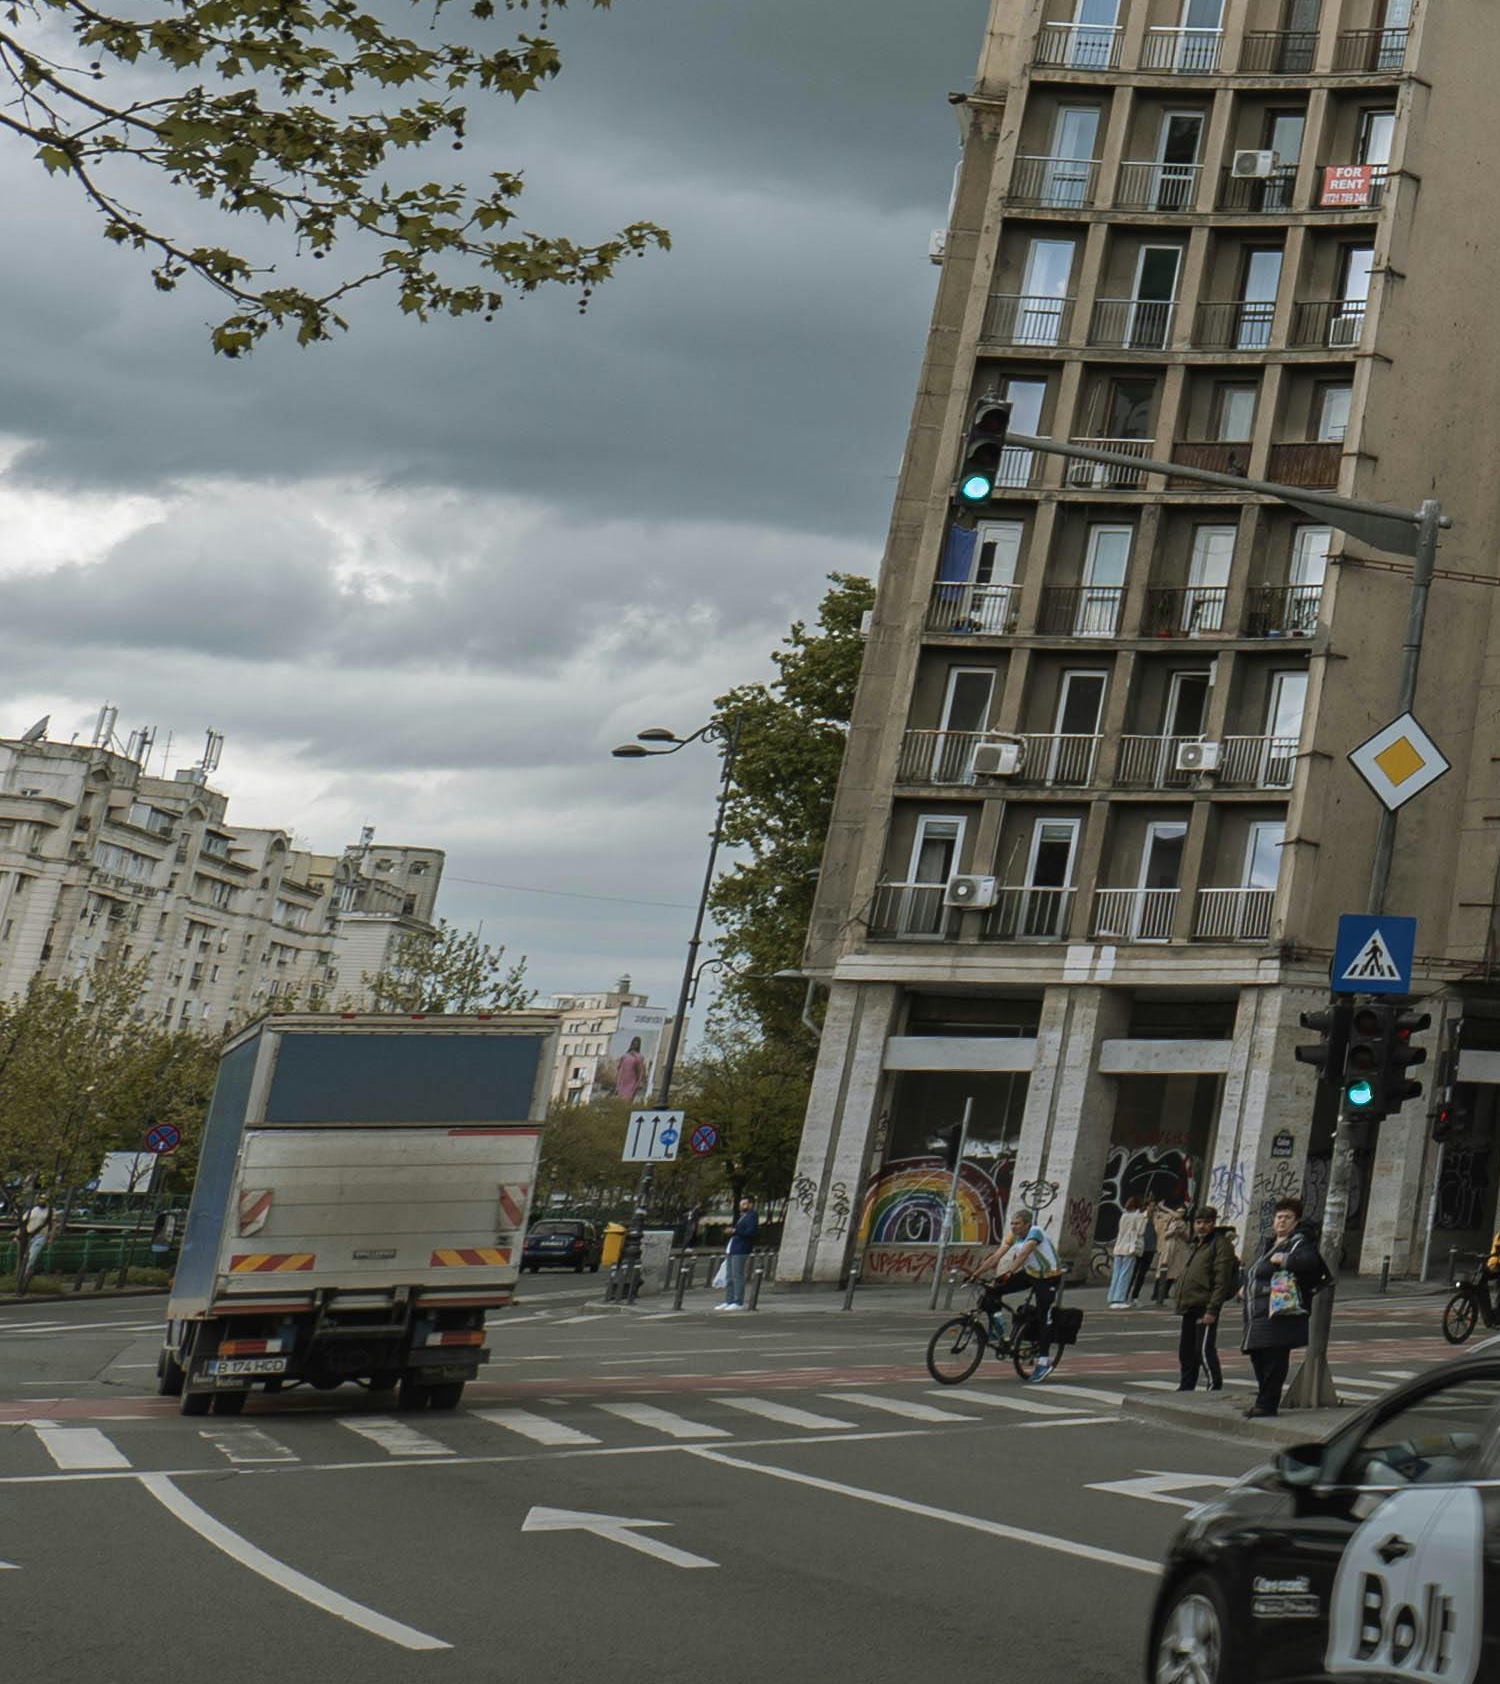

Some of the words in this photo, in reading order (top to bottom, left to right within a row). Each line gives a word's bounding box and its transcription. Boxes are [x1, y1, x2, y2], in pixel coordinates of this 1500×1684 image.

[1336, 167, 1362, 177] FOR
[1330, 179, 1364, 189] RENT
[219, 1362, 227, 1374] B
[233, 1361, 252, 1373] 174
[255, 1359, 284, 1372] HCD
[1350, 1571, 1456, 1674] Bolt
